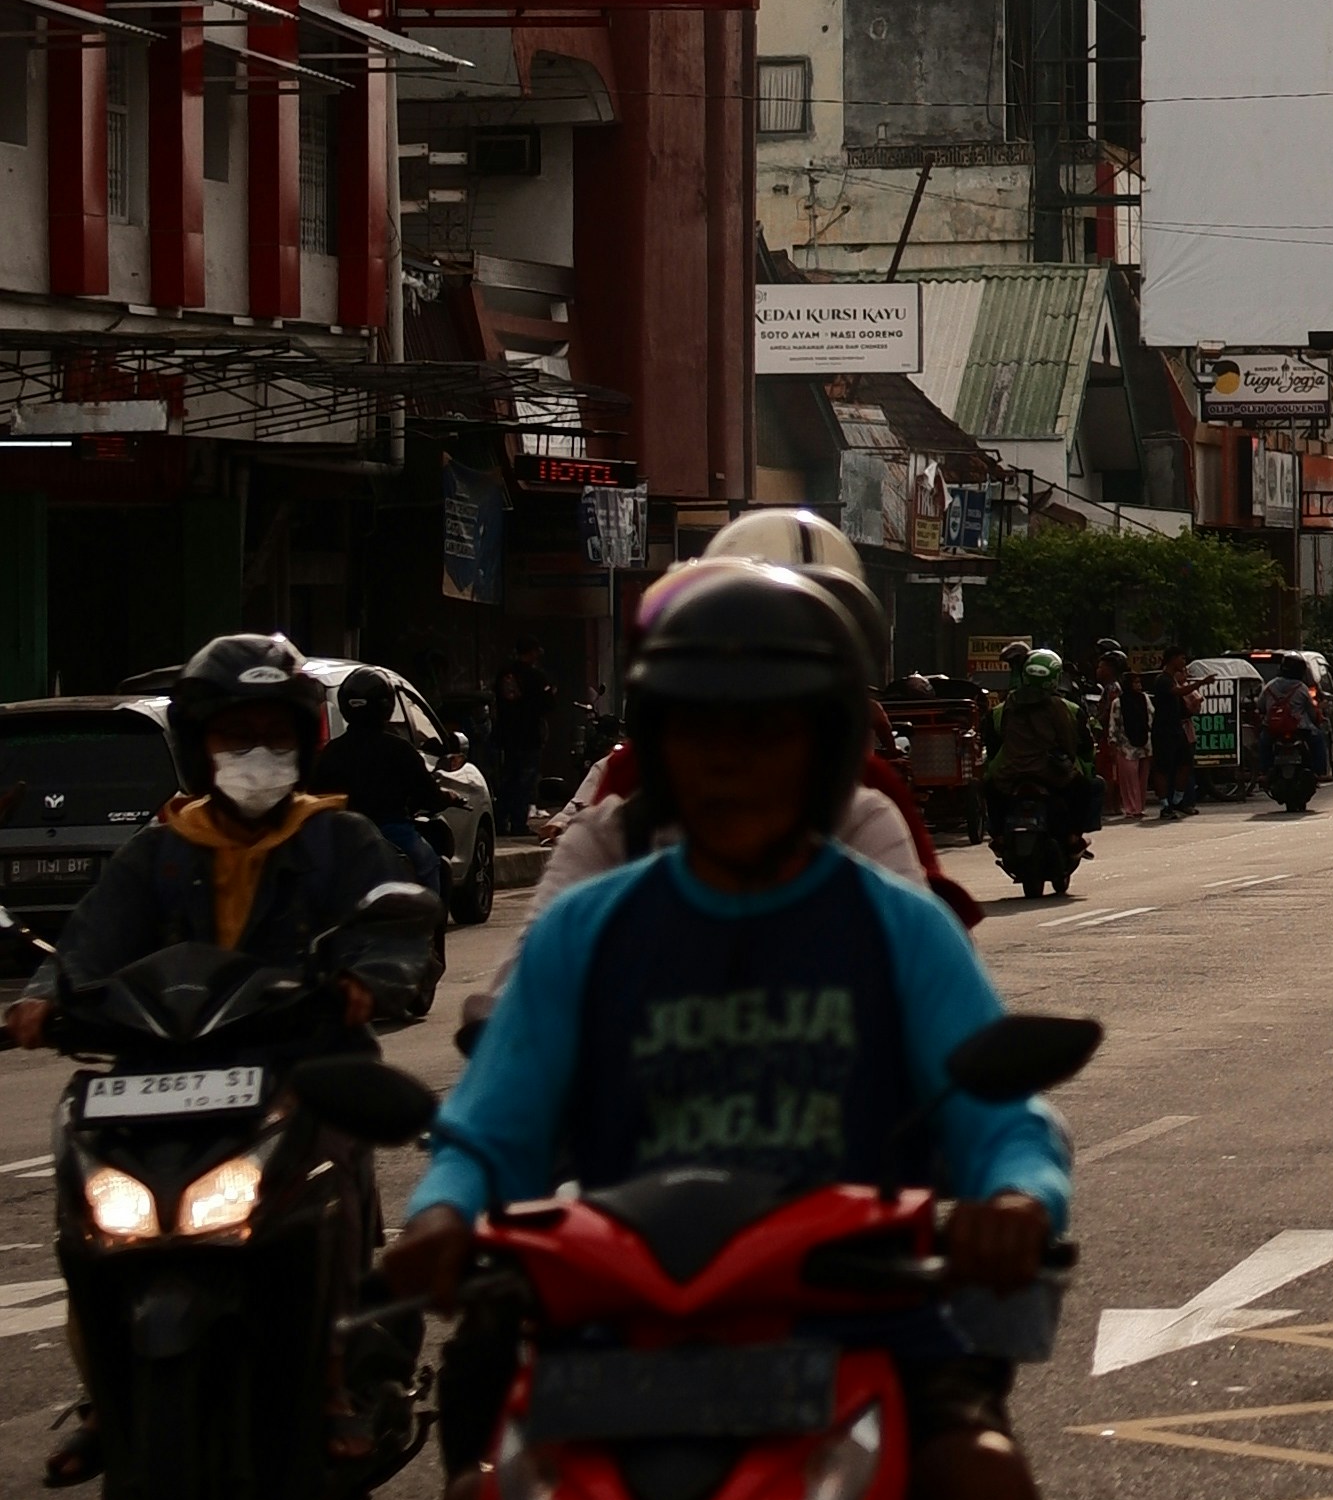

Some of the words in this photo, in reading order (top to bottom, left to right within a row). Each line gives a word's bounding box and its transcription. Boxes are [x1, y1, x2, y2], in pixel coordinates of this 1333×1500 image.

[756, 309, 801, 324] KEDAI
[806, 308, 857, 324] KURSI
[863, 307, 907, 323] KAYU
[760, 330, 789, 340] SOTO
[791, 330, 820, 340] AYAM
[830, 330, 856, 340] NASI
[859, 329, 903, 339] GORENG
[1243, 370, 1283, 394] tugu
[1278, 371, 1326, 394] jogja
[632, 988, 857, 1058] JOGJA
[94, 1079, 126, 1097] AB
[141, 1073, 206, 1094] 2667
[636, 1083, 848, 1159] JOGJA
